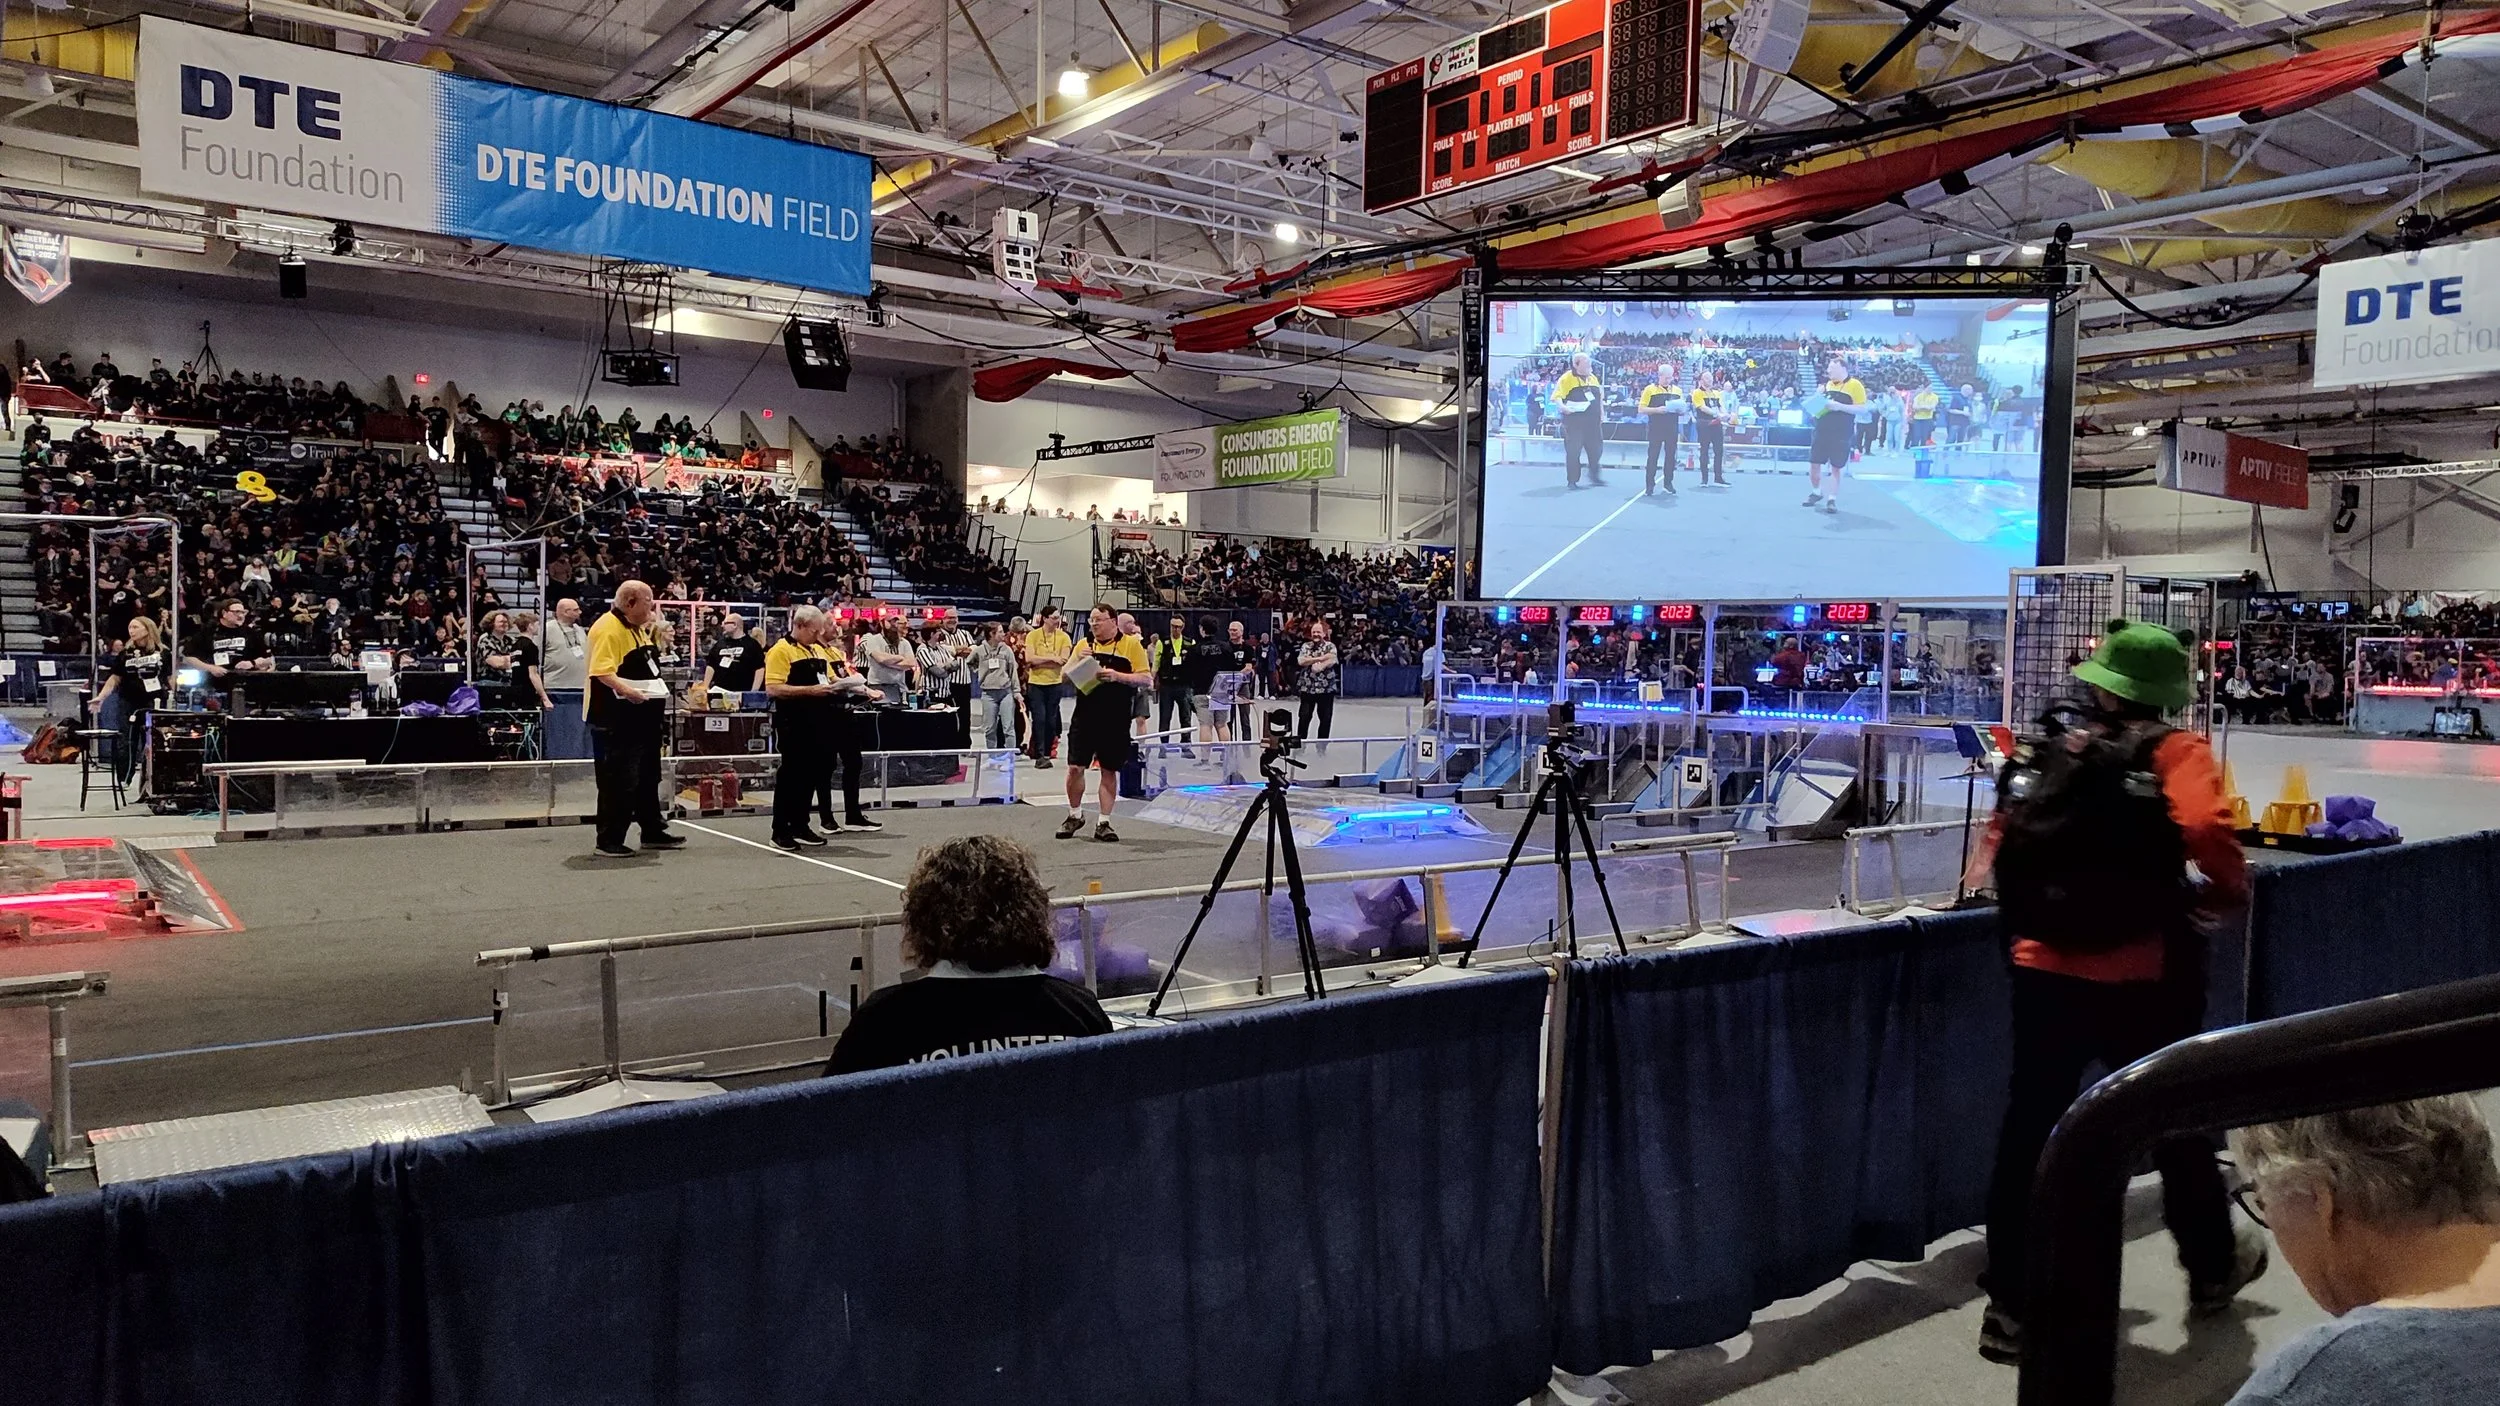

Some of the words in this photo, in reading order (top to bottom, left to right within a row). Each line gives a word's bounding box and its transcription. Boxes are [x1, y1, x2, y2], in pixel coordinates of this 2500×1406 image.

[1406, 64, 1418, 77] PTS
[1448, 56, 1475, 72] PIZZA
[1497, 69, 1523, 86] PERIOD
[181, 64, 341, 140] DTE
[1569, 91, 1594, 109] FOULS
[1487, 118, 1513, 135] PLAYER
[1515, 111, 1534, 128] FOUL
[1433, 137, 1454, 152] FOULS
[1567, 135, 1593, 152] SCORE
[181, 125, 404, 203] Foundation
[1495, 157, 1520, 173] MATCH
[476, 143, 547, 191] DTE
[555, 156, 773, 228] FOUNDATION
[783, 197, 859, 242] FIELD
[1431, 177, 1453, 192] SCORE
[2345, 276, 2463, 326] DTE
[2342, 321, 2500, 367] Foundatio
[1221, 428, 1287, 454] CONSUMERS
[1289, 420, 1336, 446] ENERGY
[1185, 446, 1203, 456] Energy
[1221, 451, 1298, 478] FOUNDATION
[1301, 447, 1333, 470] FIELD
[2183, 450, 2217, 468] APTIV
[2239, 456, 2272, 481] APTIV
[1160, 469, 1206, 482] FOUNDATION
[1520, 606, 1549, 620] 2023
[1580, 606, 1610, 620] 2023
[1660, 605, 1693, 619] 2023
[1827, 604, 1867, 619] 2023
[909, 1035, 1078, 1064] VOLUNTE
